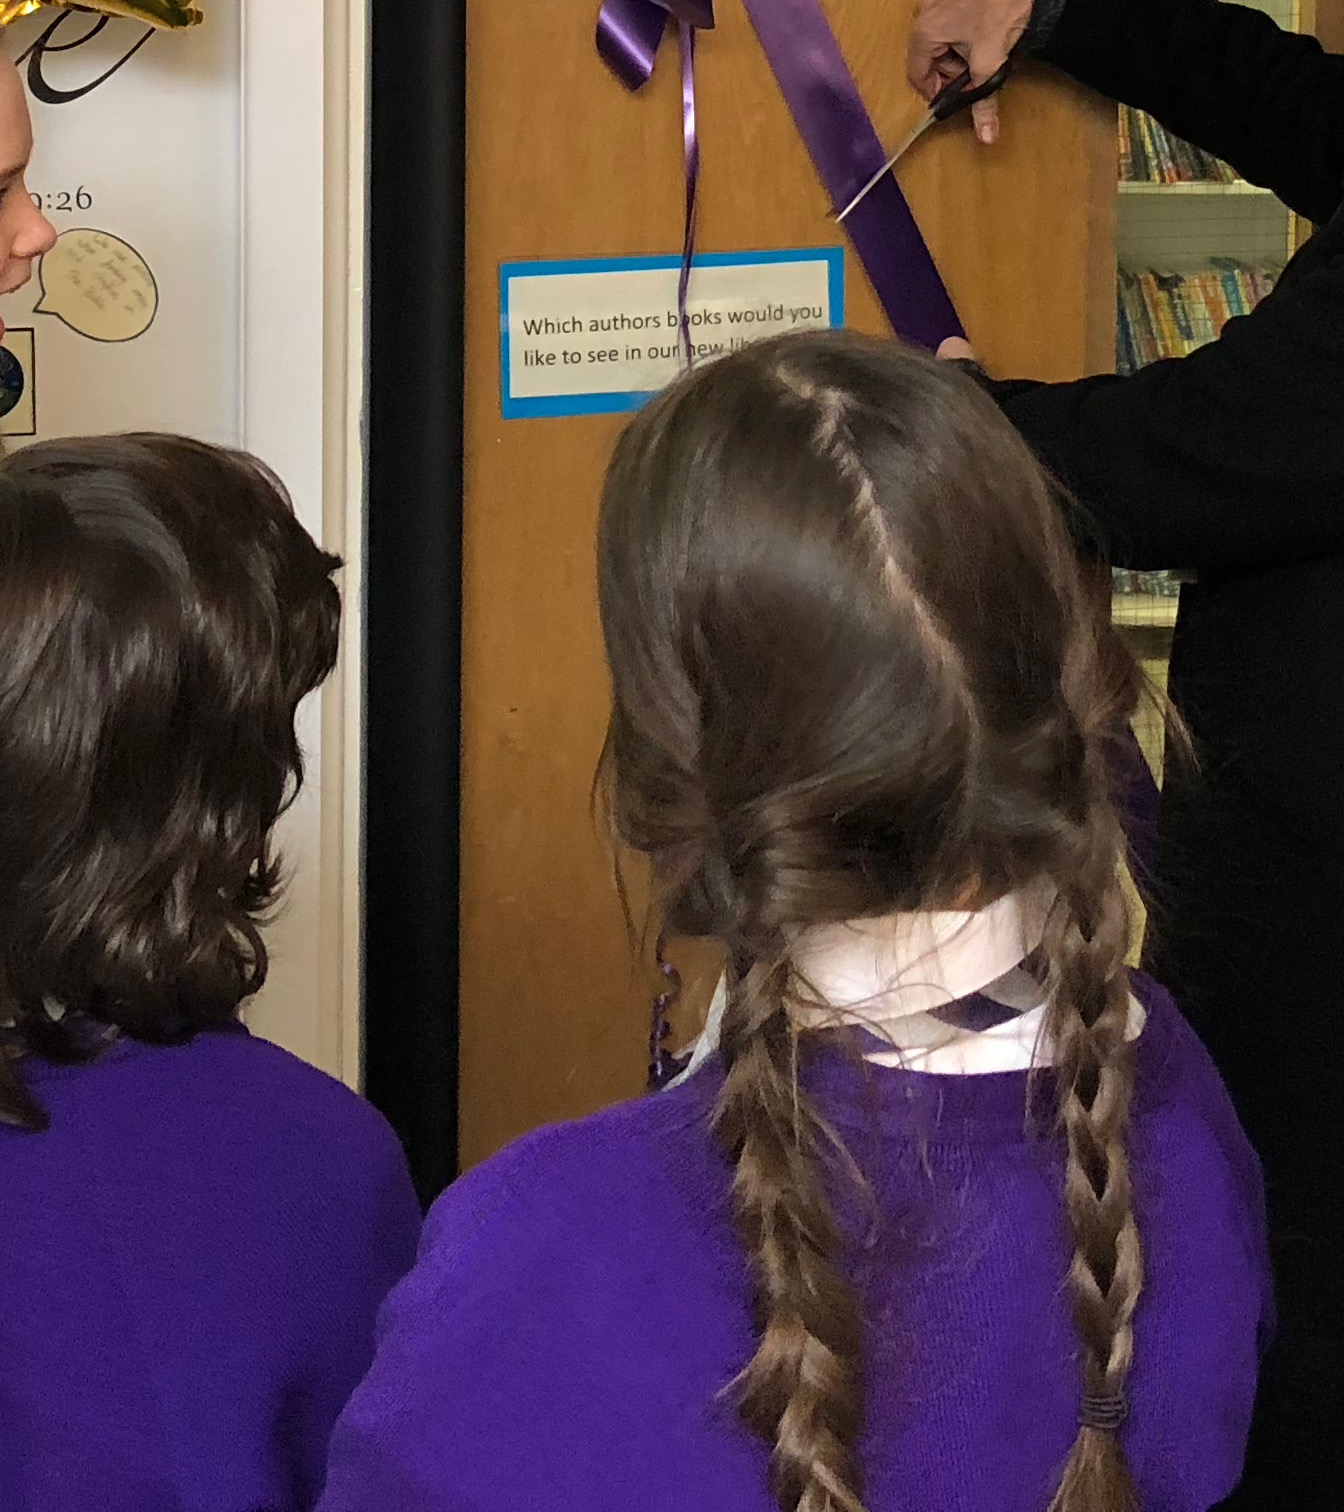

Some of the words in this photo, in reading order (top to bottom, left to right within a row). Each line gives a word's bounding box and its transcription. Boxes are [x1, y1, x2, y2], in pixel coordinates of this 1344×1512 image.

[523, 318, 583, 337] Which
[588, 312, 661, 333] authors
[667, 309, 722, 328] books
[727, 304, 784, 324] would
[790, 306, 823, 324] you
[523, 349, 557, 367] like
[561, 347, 582, 365] to
[587, 346, 619, 363] see
[624, 344, 643, 362] in
[647, 343, 680, 360] our
